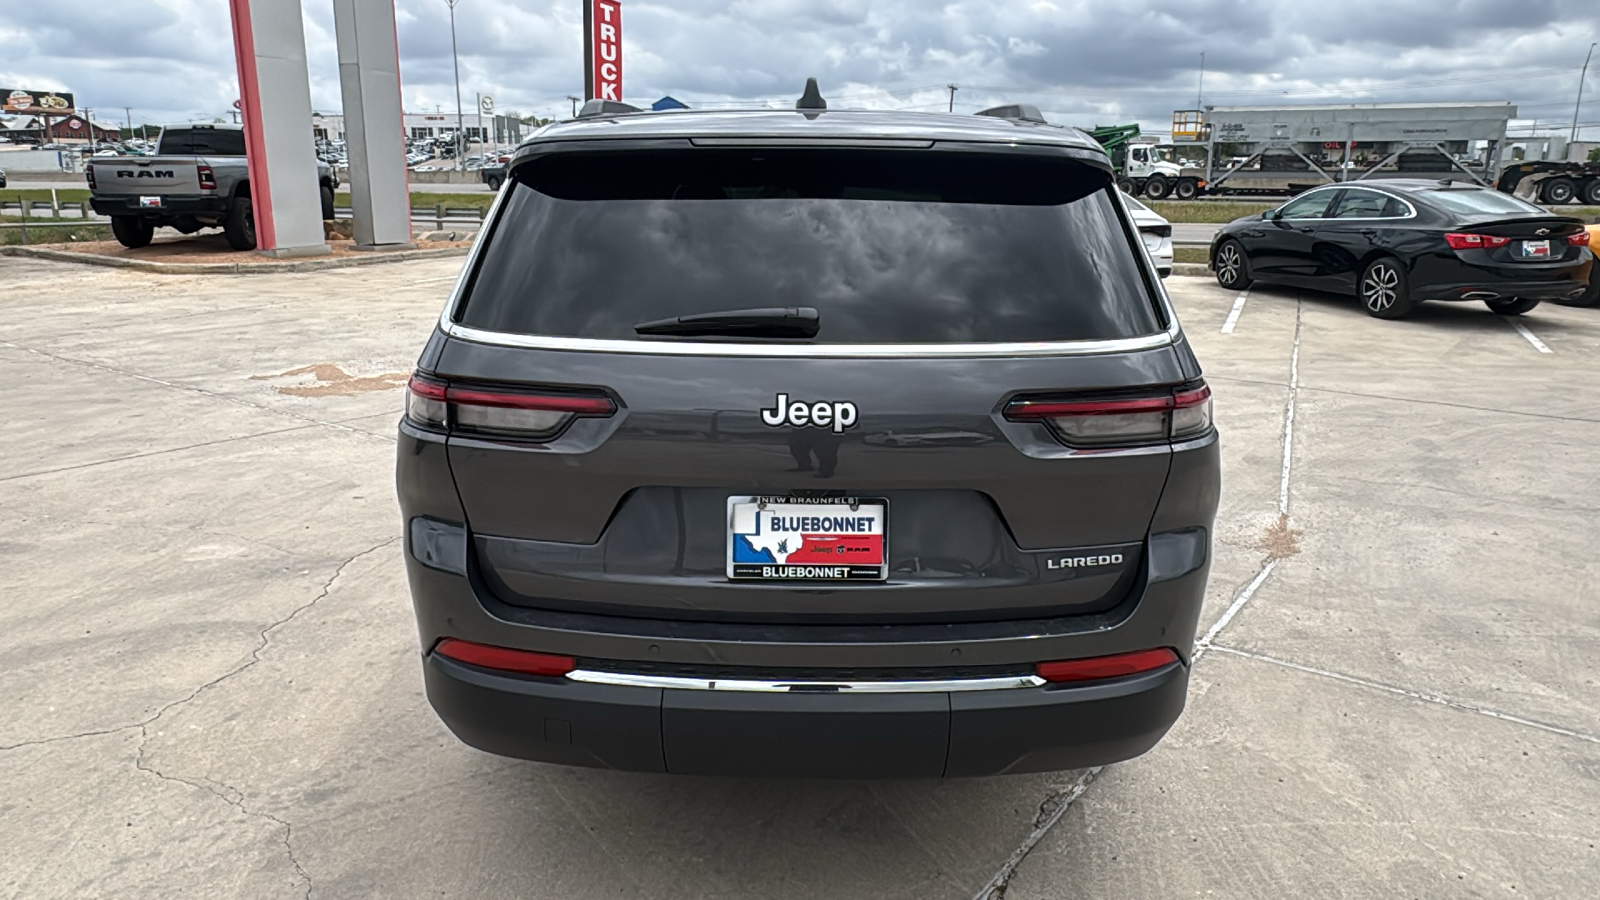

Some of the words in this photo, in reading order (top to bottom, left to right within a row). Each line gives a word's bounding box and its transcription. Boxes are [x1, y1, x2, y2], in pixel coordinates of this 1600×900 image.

[599, 2, 617, 101] TRUCK
[116, 170, 174, 179] RAM
[761, 393, 858, 433] Jeep
[789, 497, 855, 505] BRAUNFELS
[771, 516, 875, 532] BLUEBONNET
[1047, 554, 1123, 569] LAREDO
[762, 567, 850, 578] BLUEBONNET
